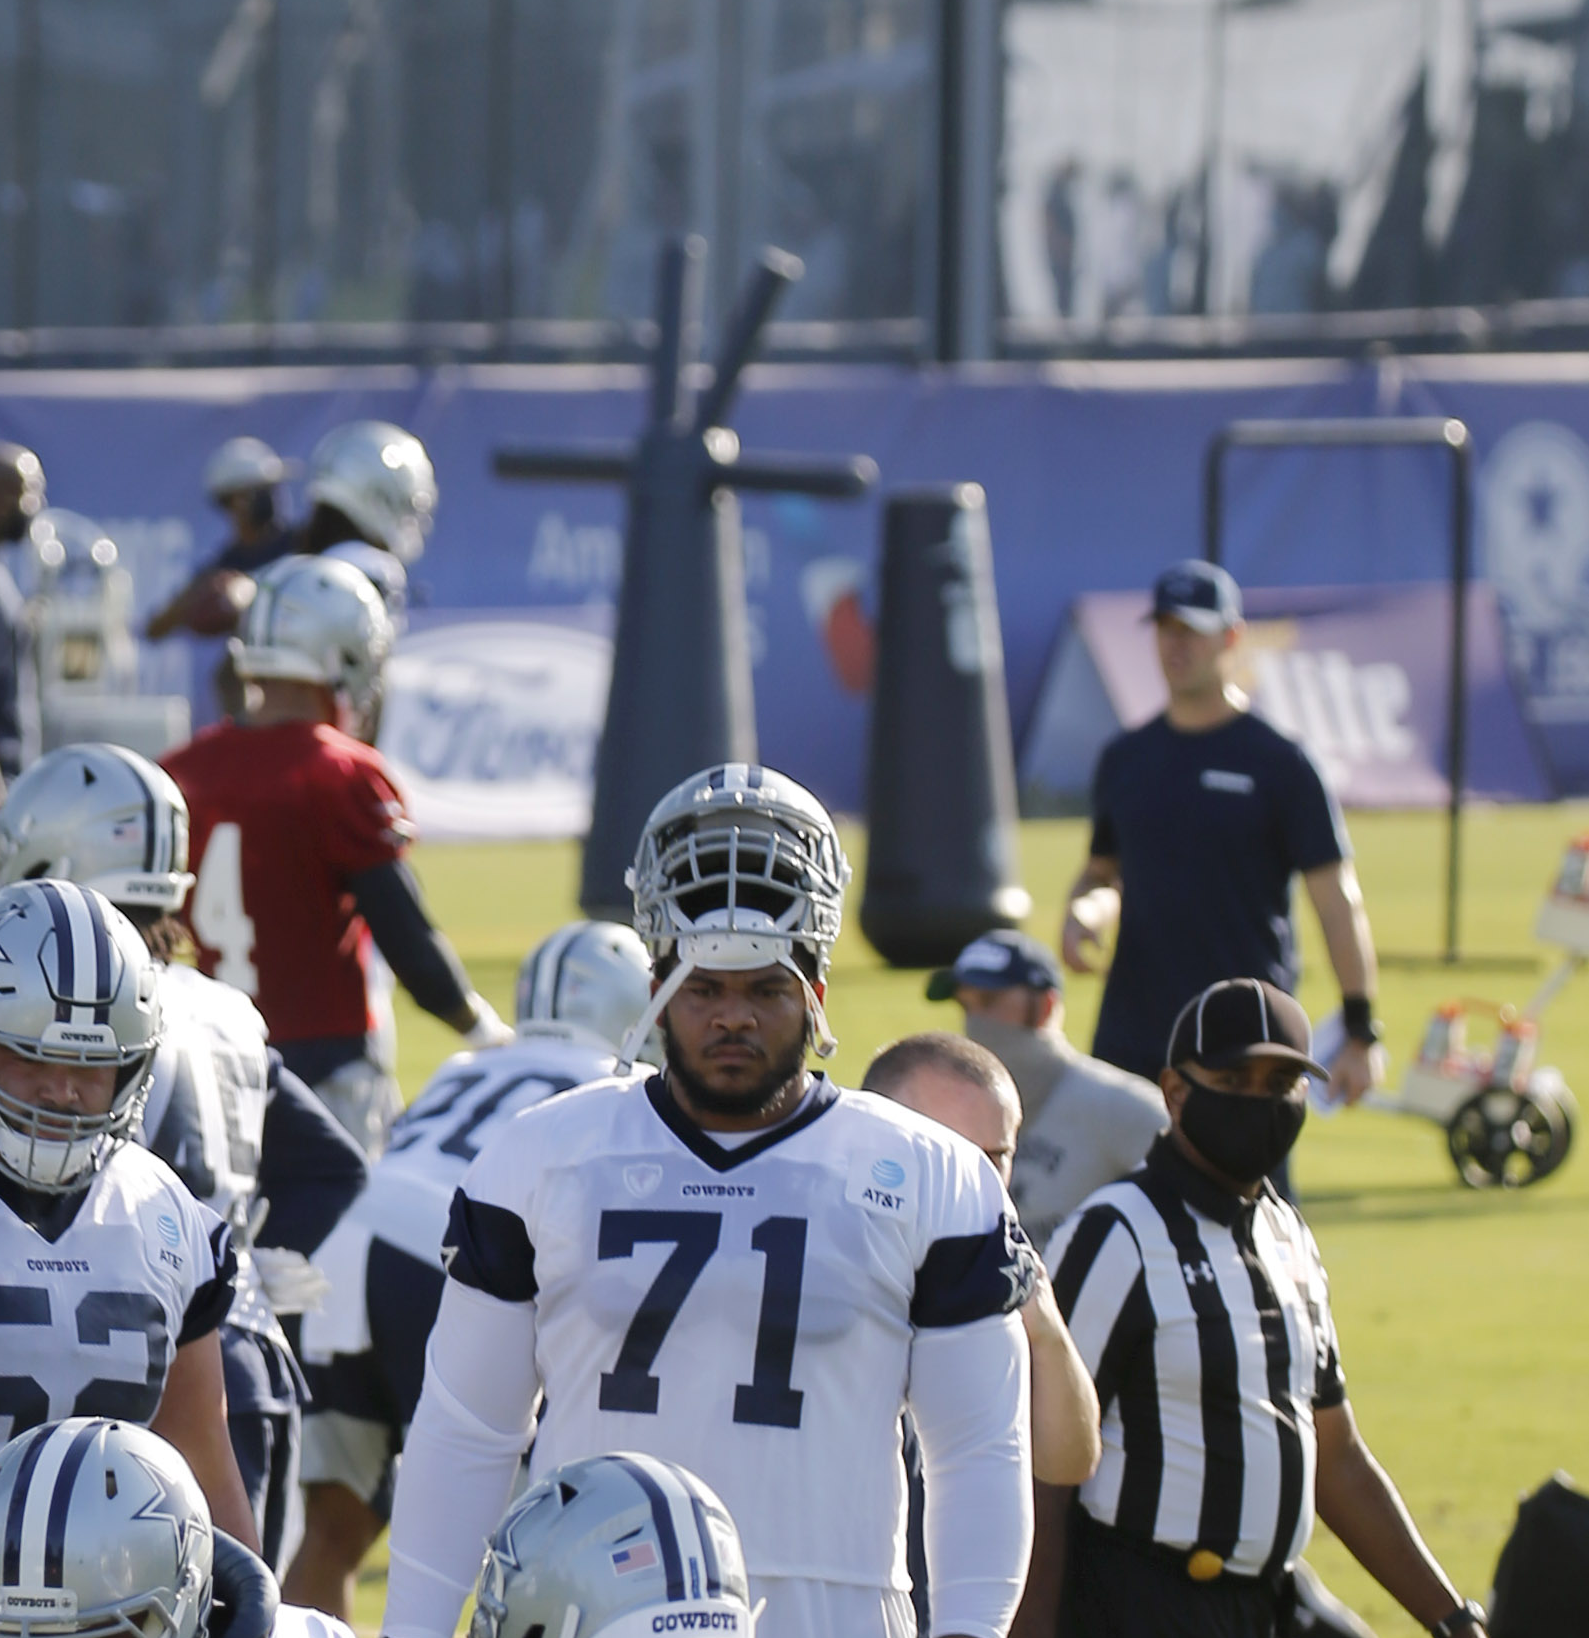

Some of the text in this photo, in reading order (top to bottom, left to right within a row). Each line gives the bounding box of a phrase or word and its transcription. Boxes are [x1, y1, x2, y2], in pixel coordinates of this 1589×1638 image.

[190, 821, 260, 1000] 4
[681, 1183, 757, 1199] COWBOYS
[862, 1188, 905, 1212] AT&T
[25, 1257, 91, 1274] COWBOYS
[598, 1210, 809, 1429] 71
[6, 1595, 58, 1610] COWBOYS
